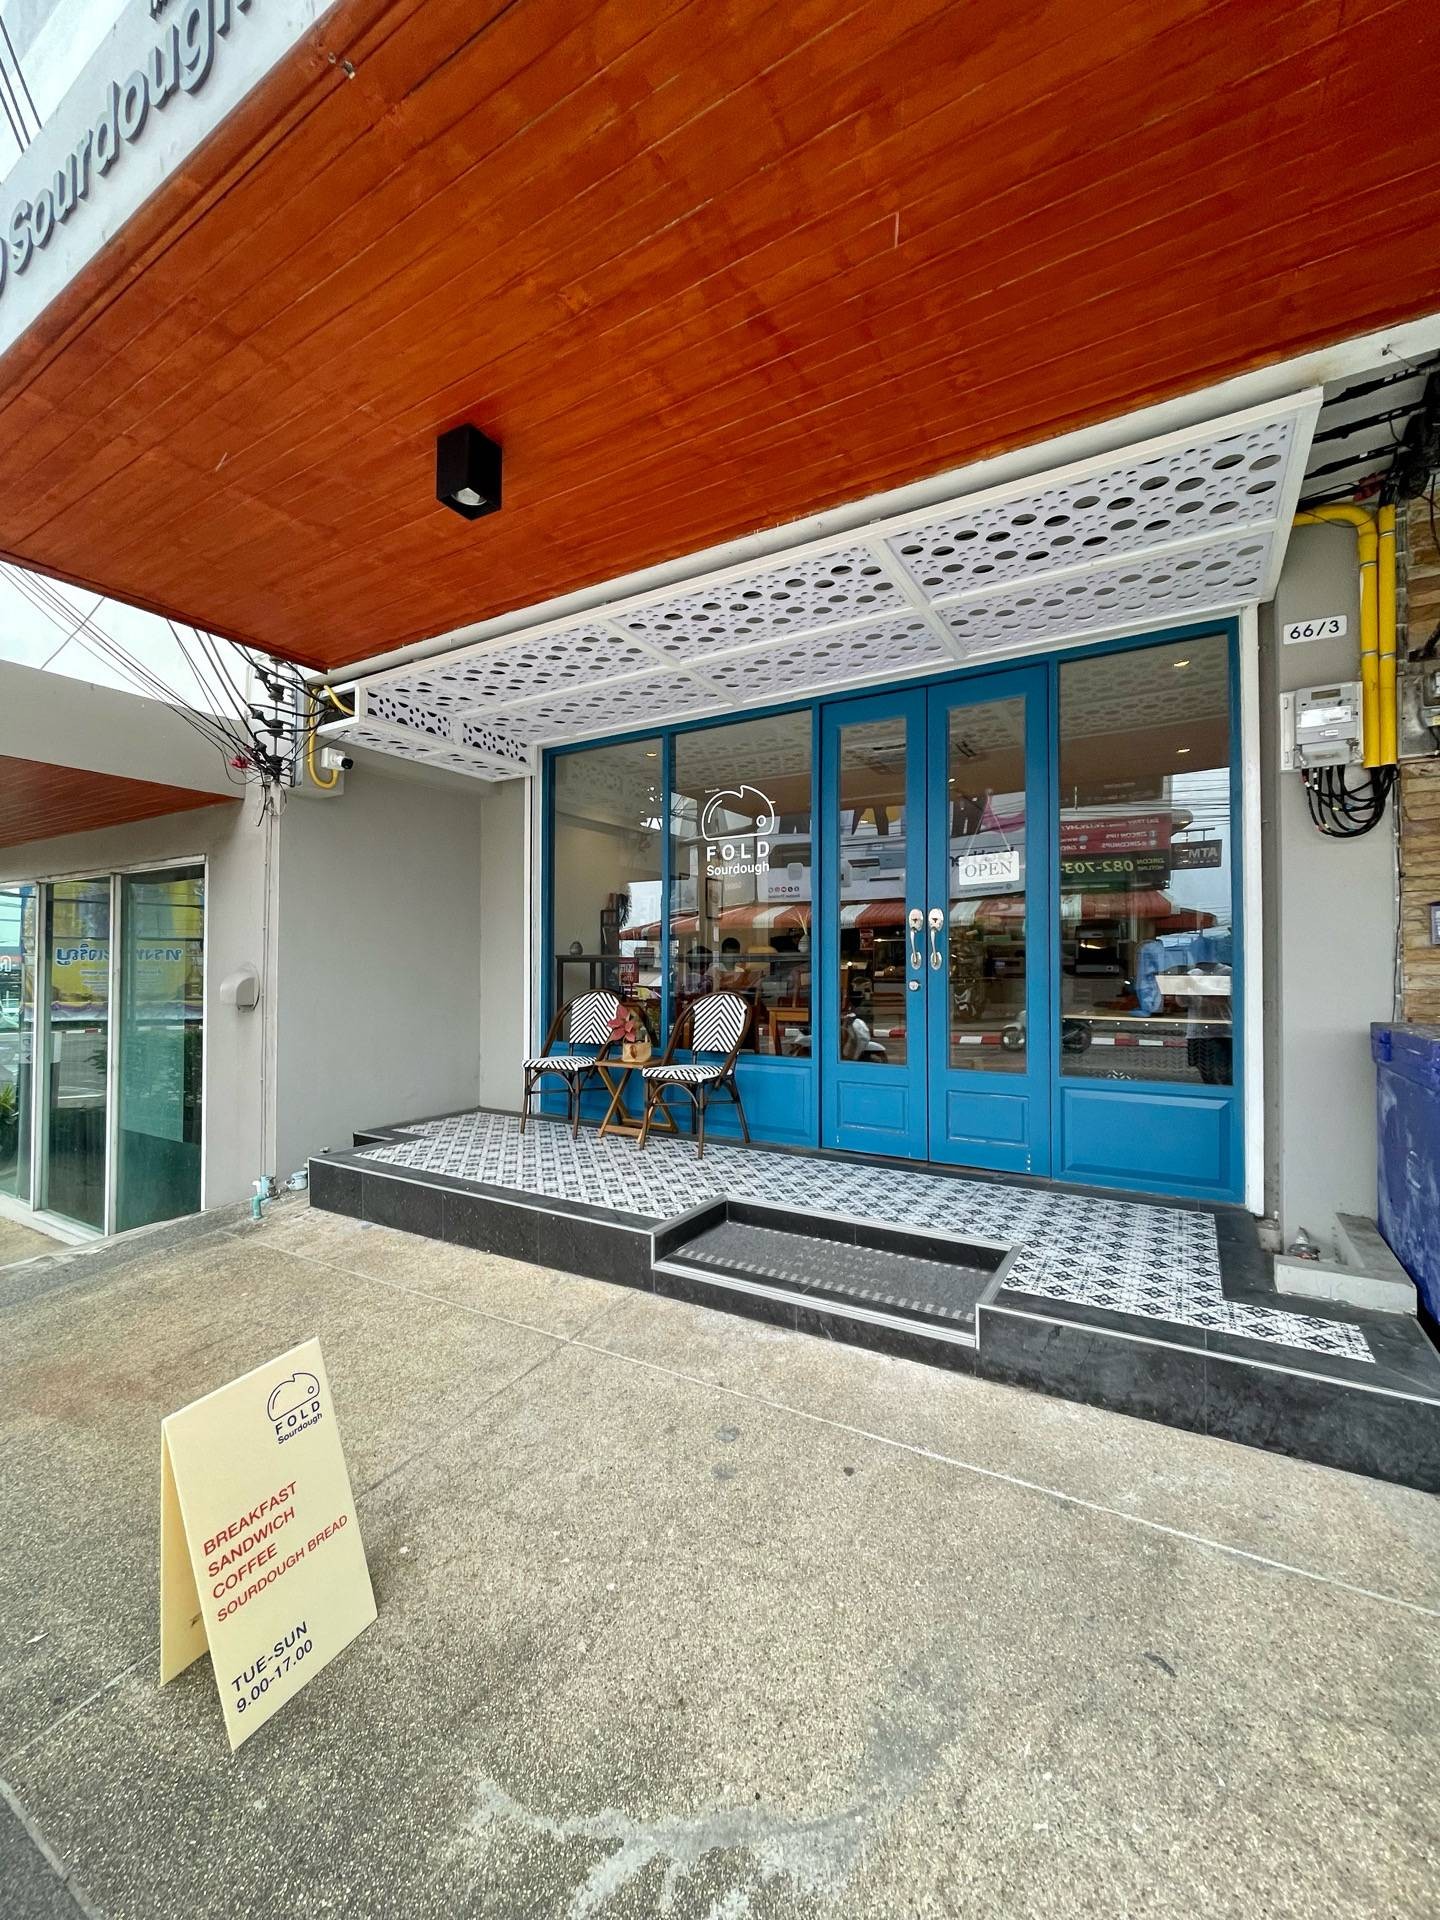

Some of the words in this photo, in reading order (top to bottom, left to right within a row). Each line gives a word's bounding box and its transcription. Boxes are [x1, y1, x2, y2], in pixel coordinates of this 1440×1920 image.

[1290, 620, 1339, 639] 66/3
[706, 841, 769, 862] FOLD
[706, 861, 769, 876] Sourdough
[965, 861, 1012, 878] OPEN
[275, 1401, 320, 1435] FOLD
[278, 1412, 322, 1444] Sourdough
[203, 1481, 296, 1556] BREAKFAST
[208, 1506, 295, 1577] SANDWICH
[213, 1542, 278, 1599] COFFEE
[217, 1547, 305, 1622] SOURDOUGH
[307, 1515, 348, 1552] BREAD
[232, 1621, 307, 1692] TUE-SUN
[236, 1639, 313, 1713] 9.00-17.00
